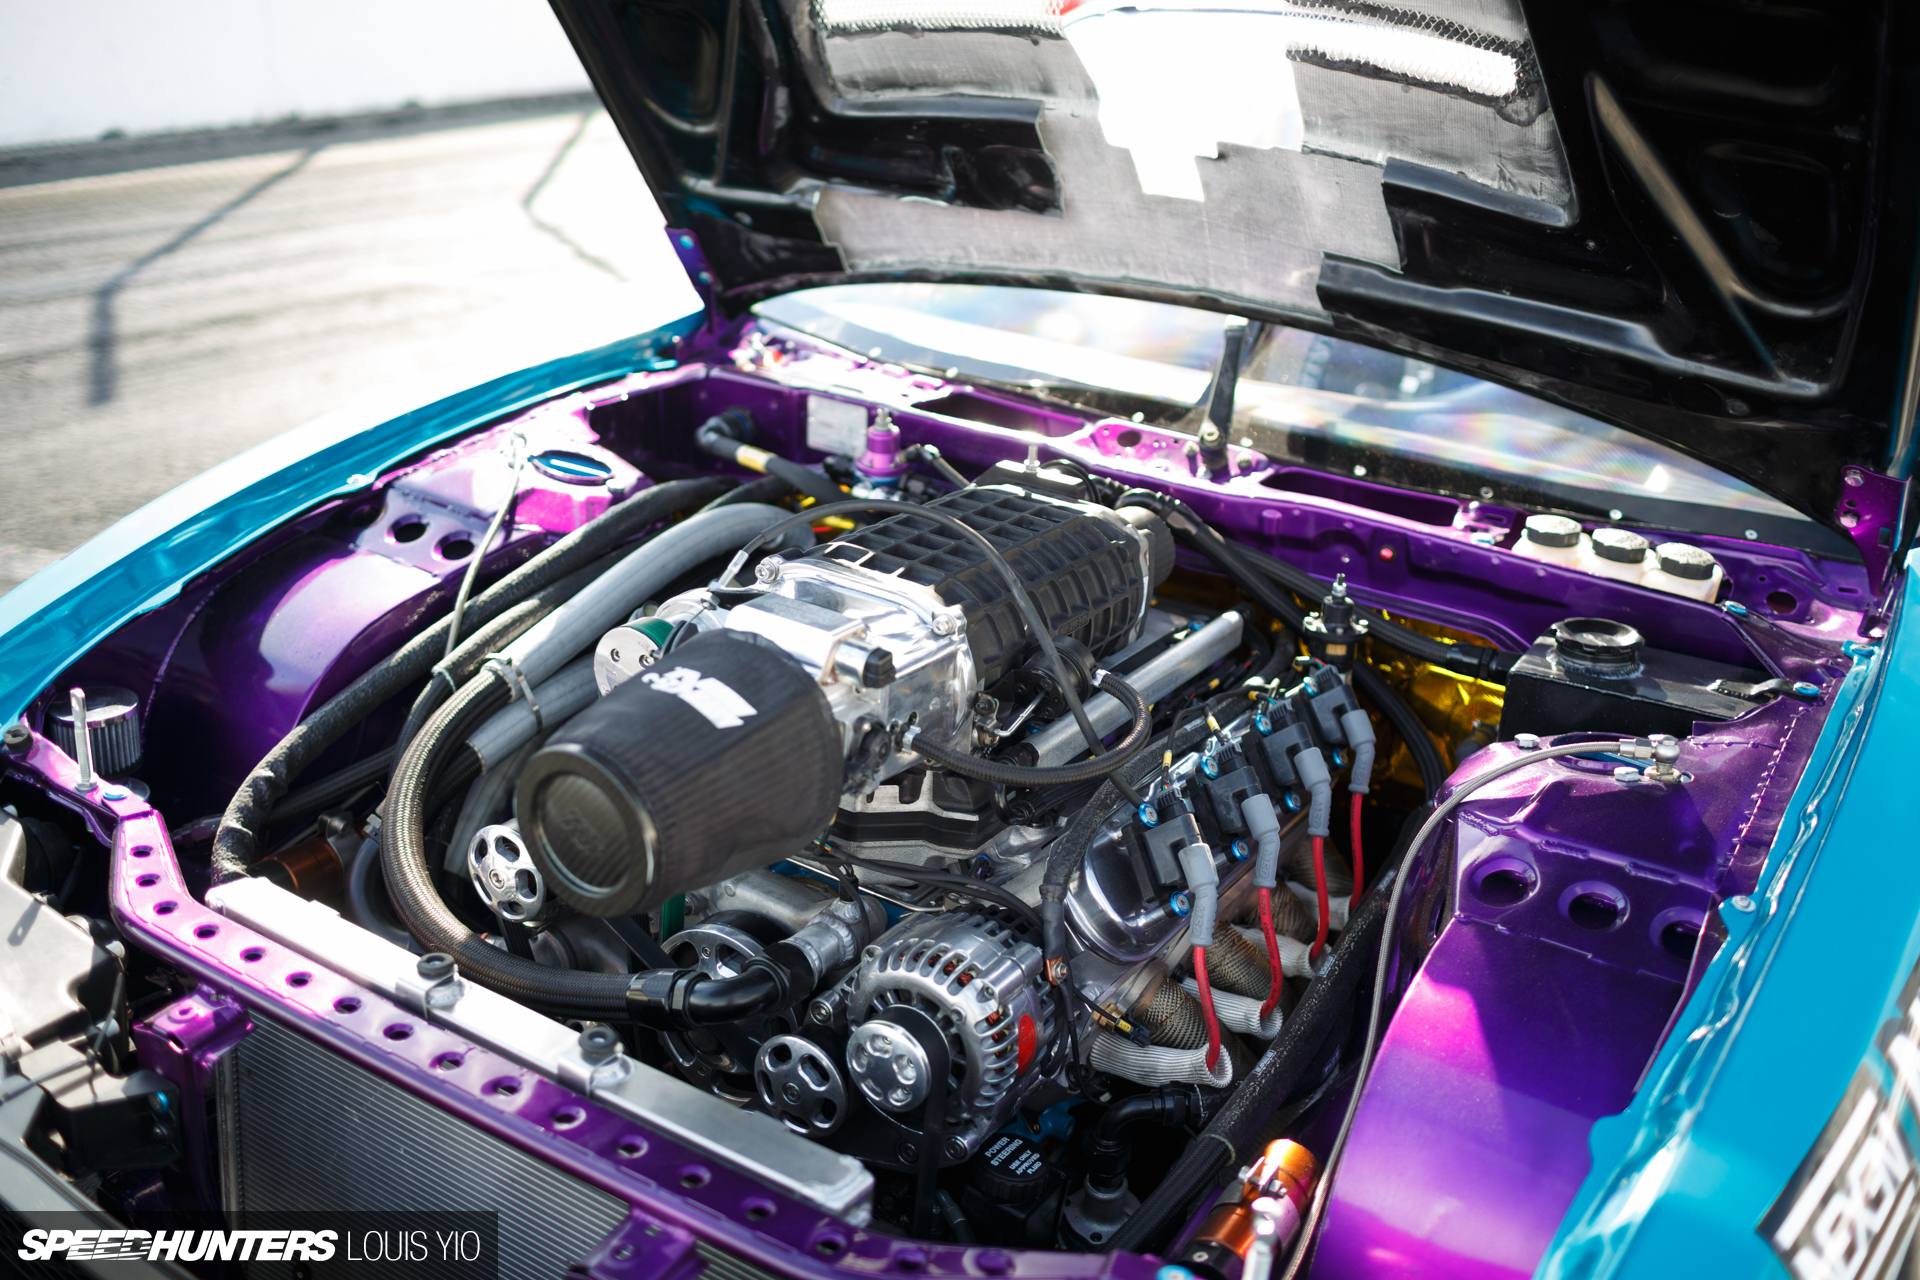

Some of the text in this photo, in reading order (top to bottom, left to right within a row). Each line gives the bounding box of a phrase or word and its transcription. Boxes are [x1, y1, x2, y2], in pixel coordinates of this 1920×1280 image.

[1260, 847, 1272, 879] MSD
[985, 1136, 1010, 1157] POWER
[990, 1139, 1023, 1166] STEERING
[1009, 1150, 1032, 1170] USE ONLY
[1016, 1153, 1040, 1175] APPROVED
[1026, 1161, 1042, 1174] FLUID
